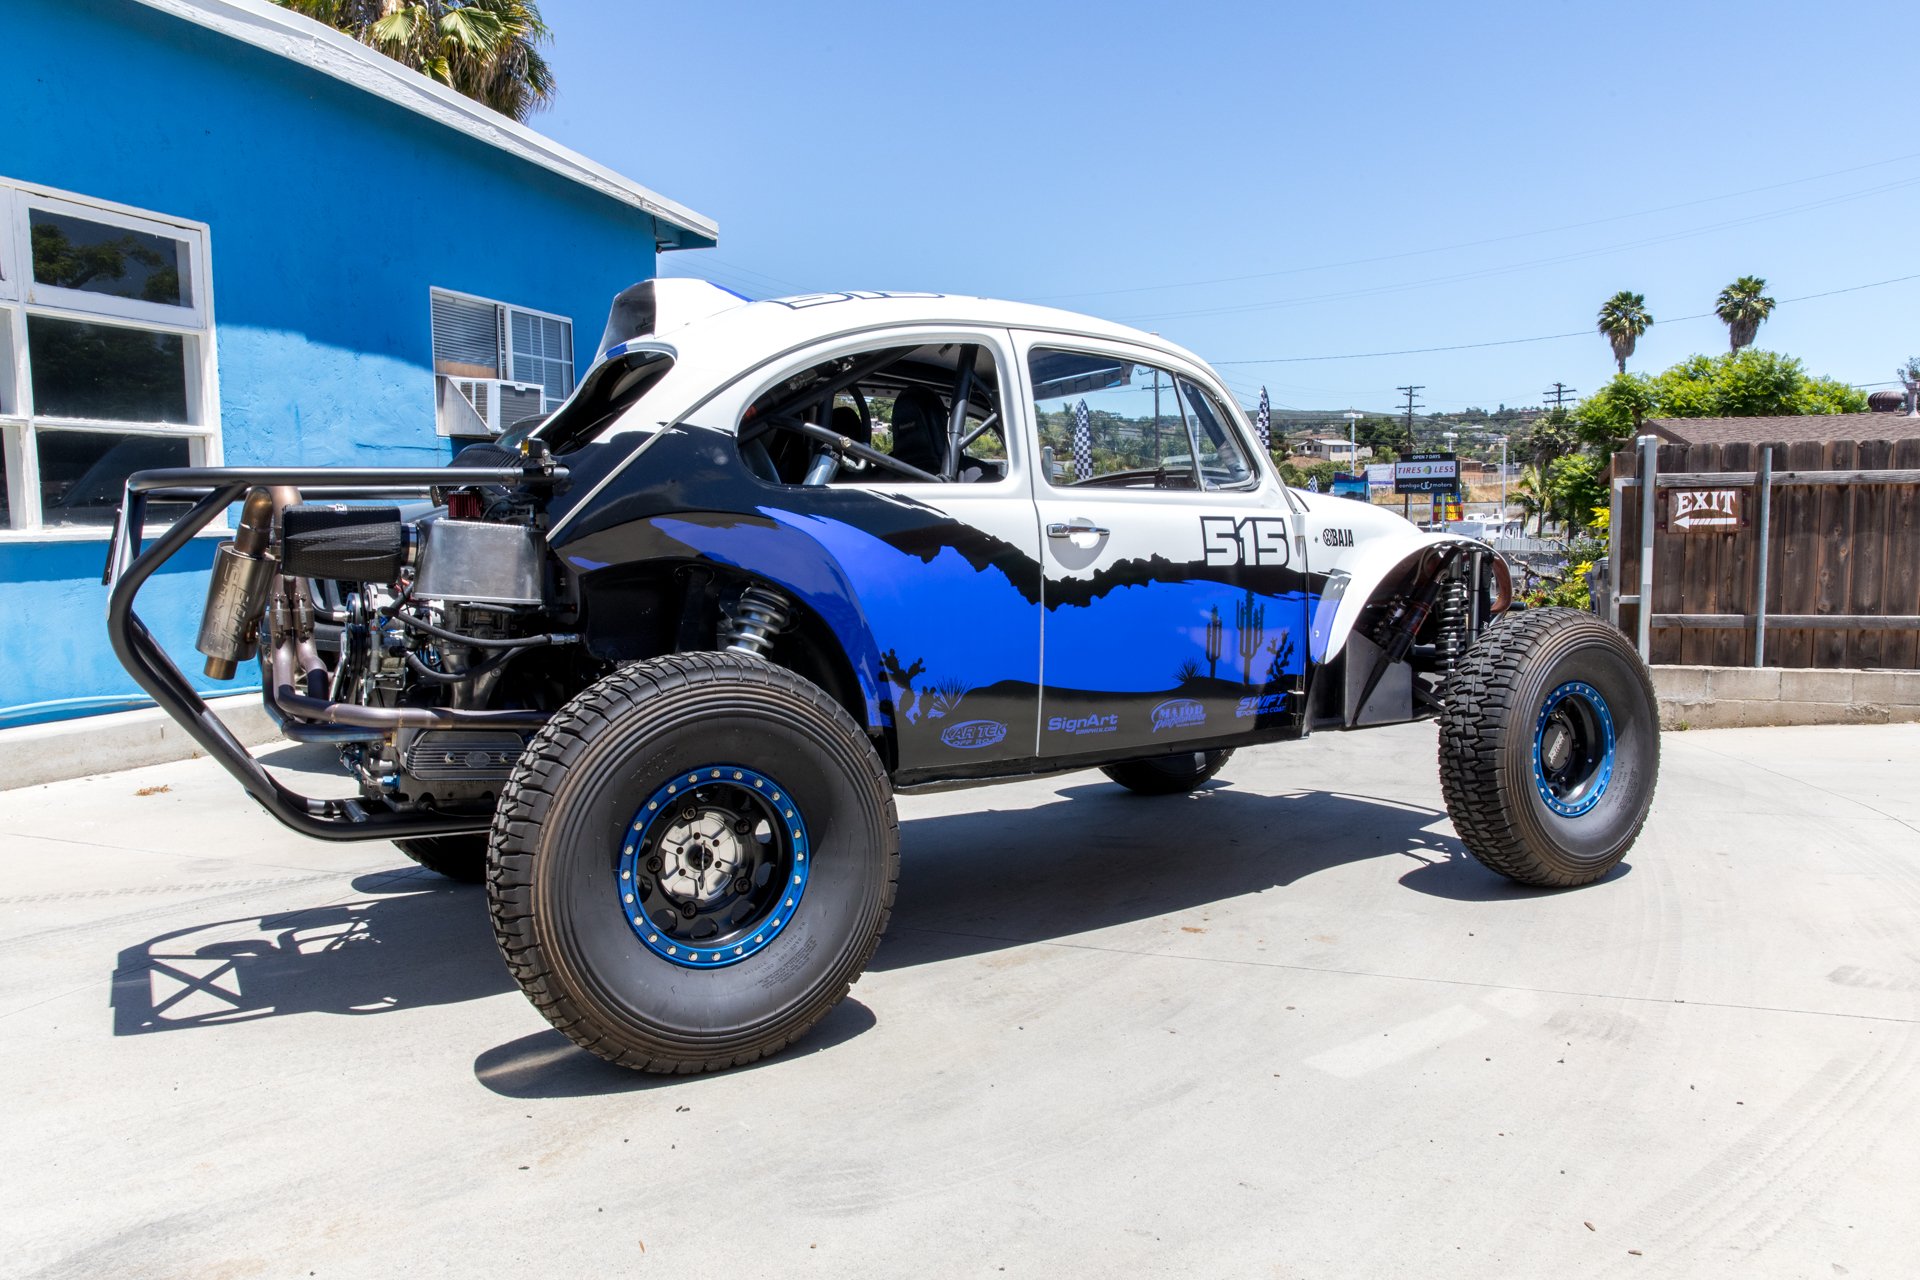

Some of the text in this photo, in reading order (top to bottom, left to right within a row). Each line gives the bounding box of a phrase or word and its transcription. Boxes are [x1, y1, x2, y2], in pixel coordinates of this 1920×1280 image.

[1675, 490, 1736, 518] EXIT
[1200, 516, 1290, 567] 515
[1331, 529, 1354, 547] BAJA
[1236, 693, 1288, 710] SWIFT
[1047, 713, 1119, 733] SignArt
[940, 726, 976, 741] KAR
